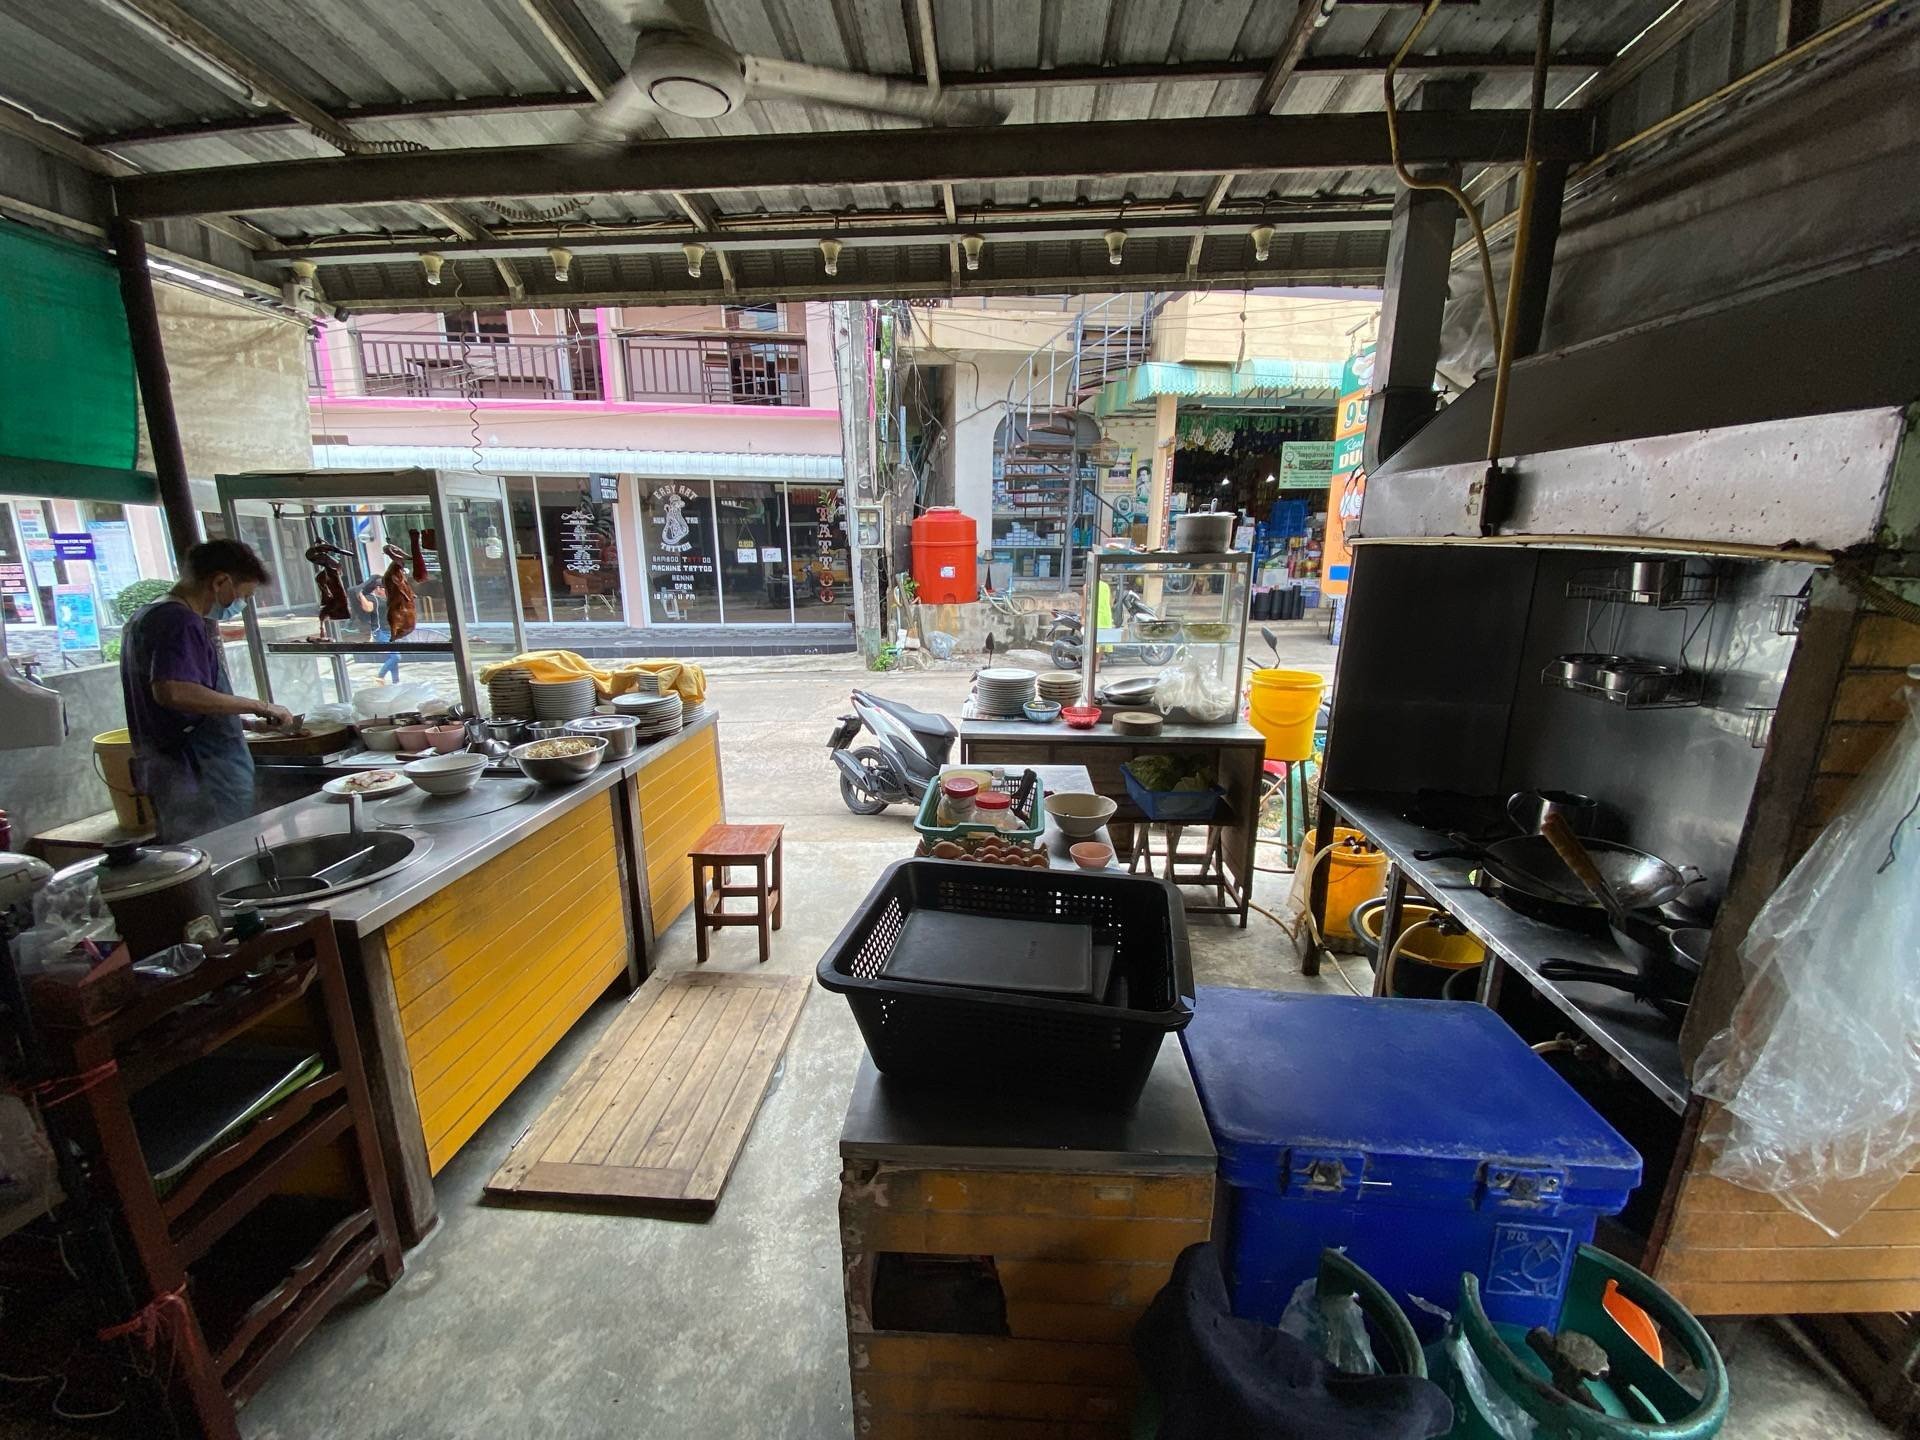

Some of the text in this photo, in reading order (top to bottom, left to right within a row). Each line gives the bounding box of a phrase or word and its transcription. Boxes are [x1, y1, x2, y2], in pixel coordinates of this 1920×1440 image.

[653, 484, 699, 501] EASY ART
[660, 541, 692, 552] TATTOO
[652, 555, 679, 563] BAMBOO
[651, 564, 682, 572] MACHINE
[671, 574, 694, 582] HENNA
